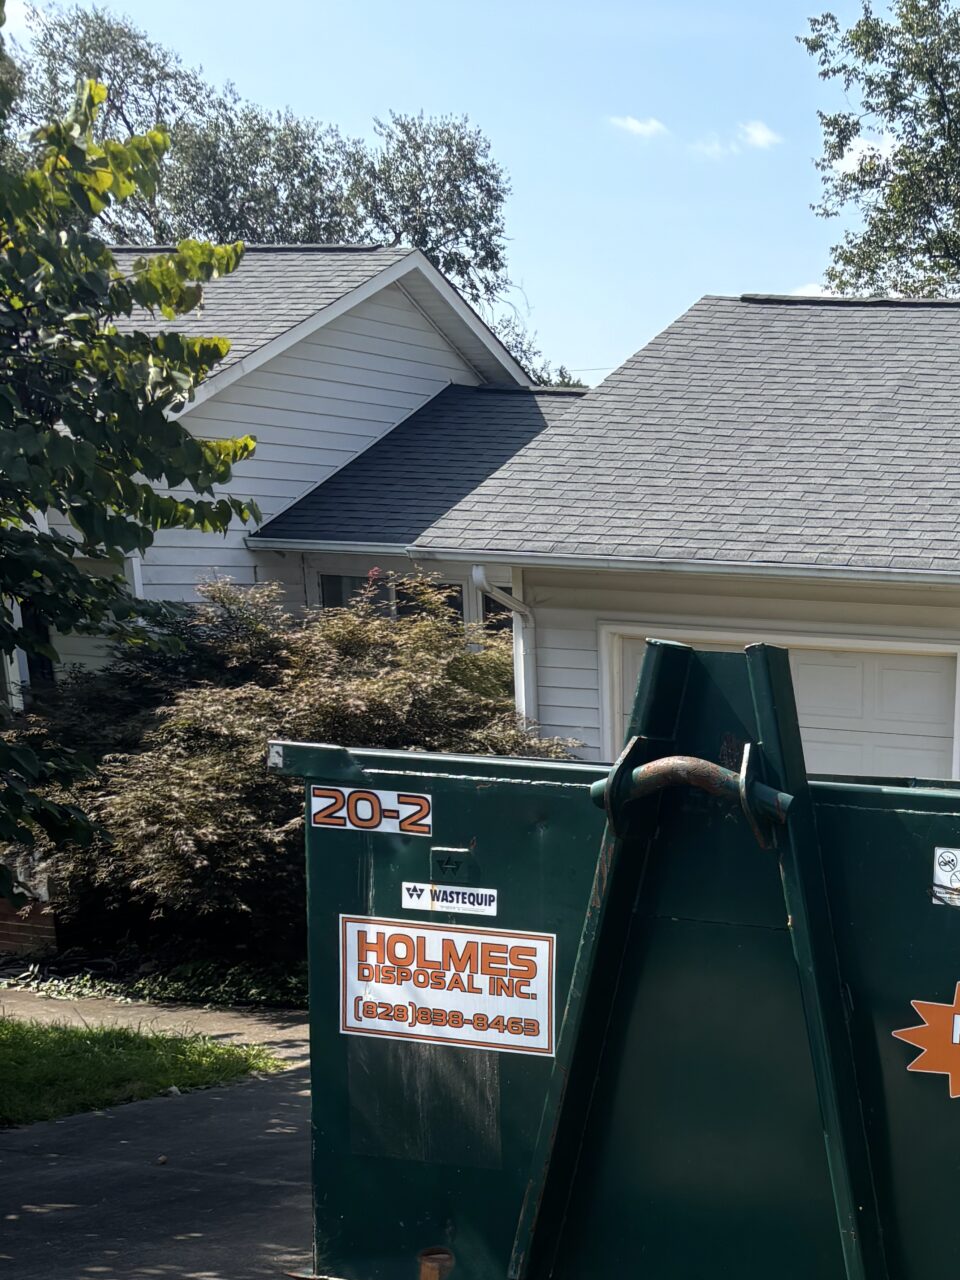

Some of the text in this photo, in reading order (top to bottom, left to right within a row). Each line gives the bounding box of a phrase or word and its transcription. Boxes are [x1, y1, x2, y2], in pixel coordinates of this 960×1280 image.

[312, 787, 431, 834] 20-2
[430, 889, 495, 907] WASTEQUIP
[356, 930, 538, 980] HOLMES
[357, 963, 538, 1000] DISPOSAL INC.
[353, 995, 541, 1037] (828)838-8463
